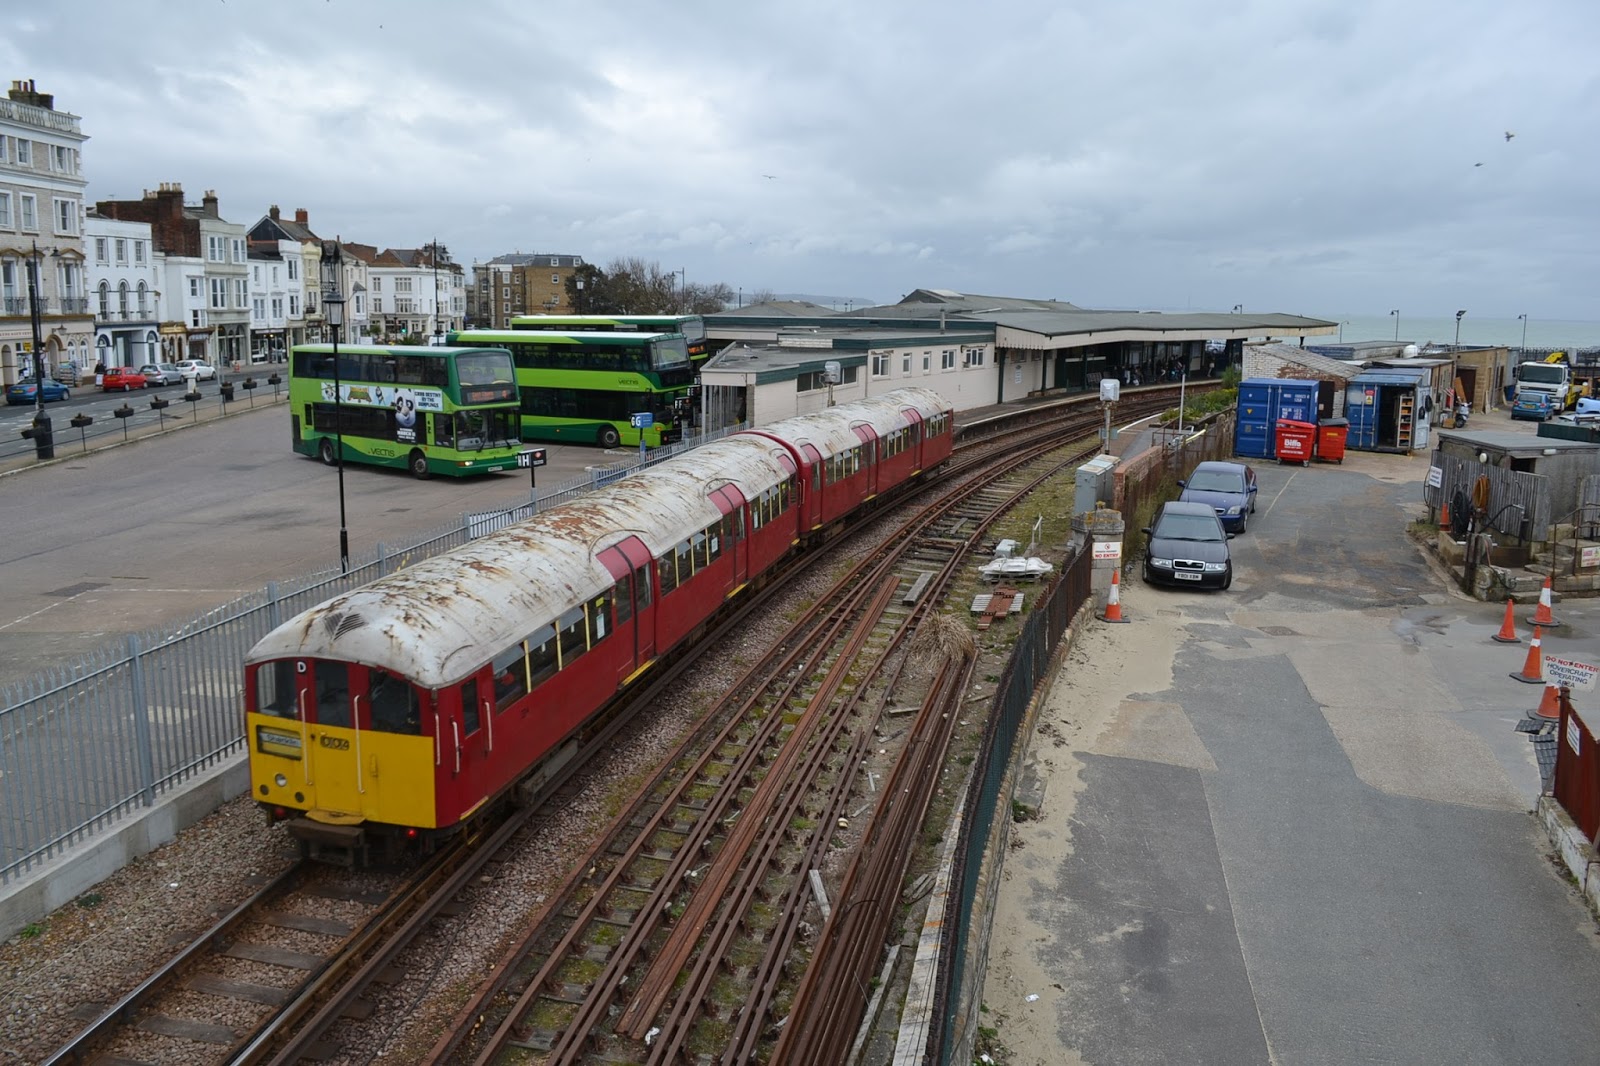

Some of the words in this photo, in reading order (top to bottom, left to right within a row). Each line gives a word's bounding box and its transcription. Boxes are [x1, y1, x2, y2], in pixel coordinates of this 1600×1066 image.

[522, 454, 530, 467] H
[297, 661, 306, 673] D
[1547, 663, 1593, 679] HOVERCRAFT
[1574, 662, 1598, 672] ENTER
[1550, 669, 1588, 684] OPERATING
[1557, 679, 1575, 688] AREA
